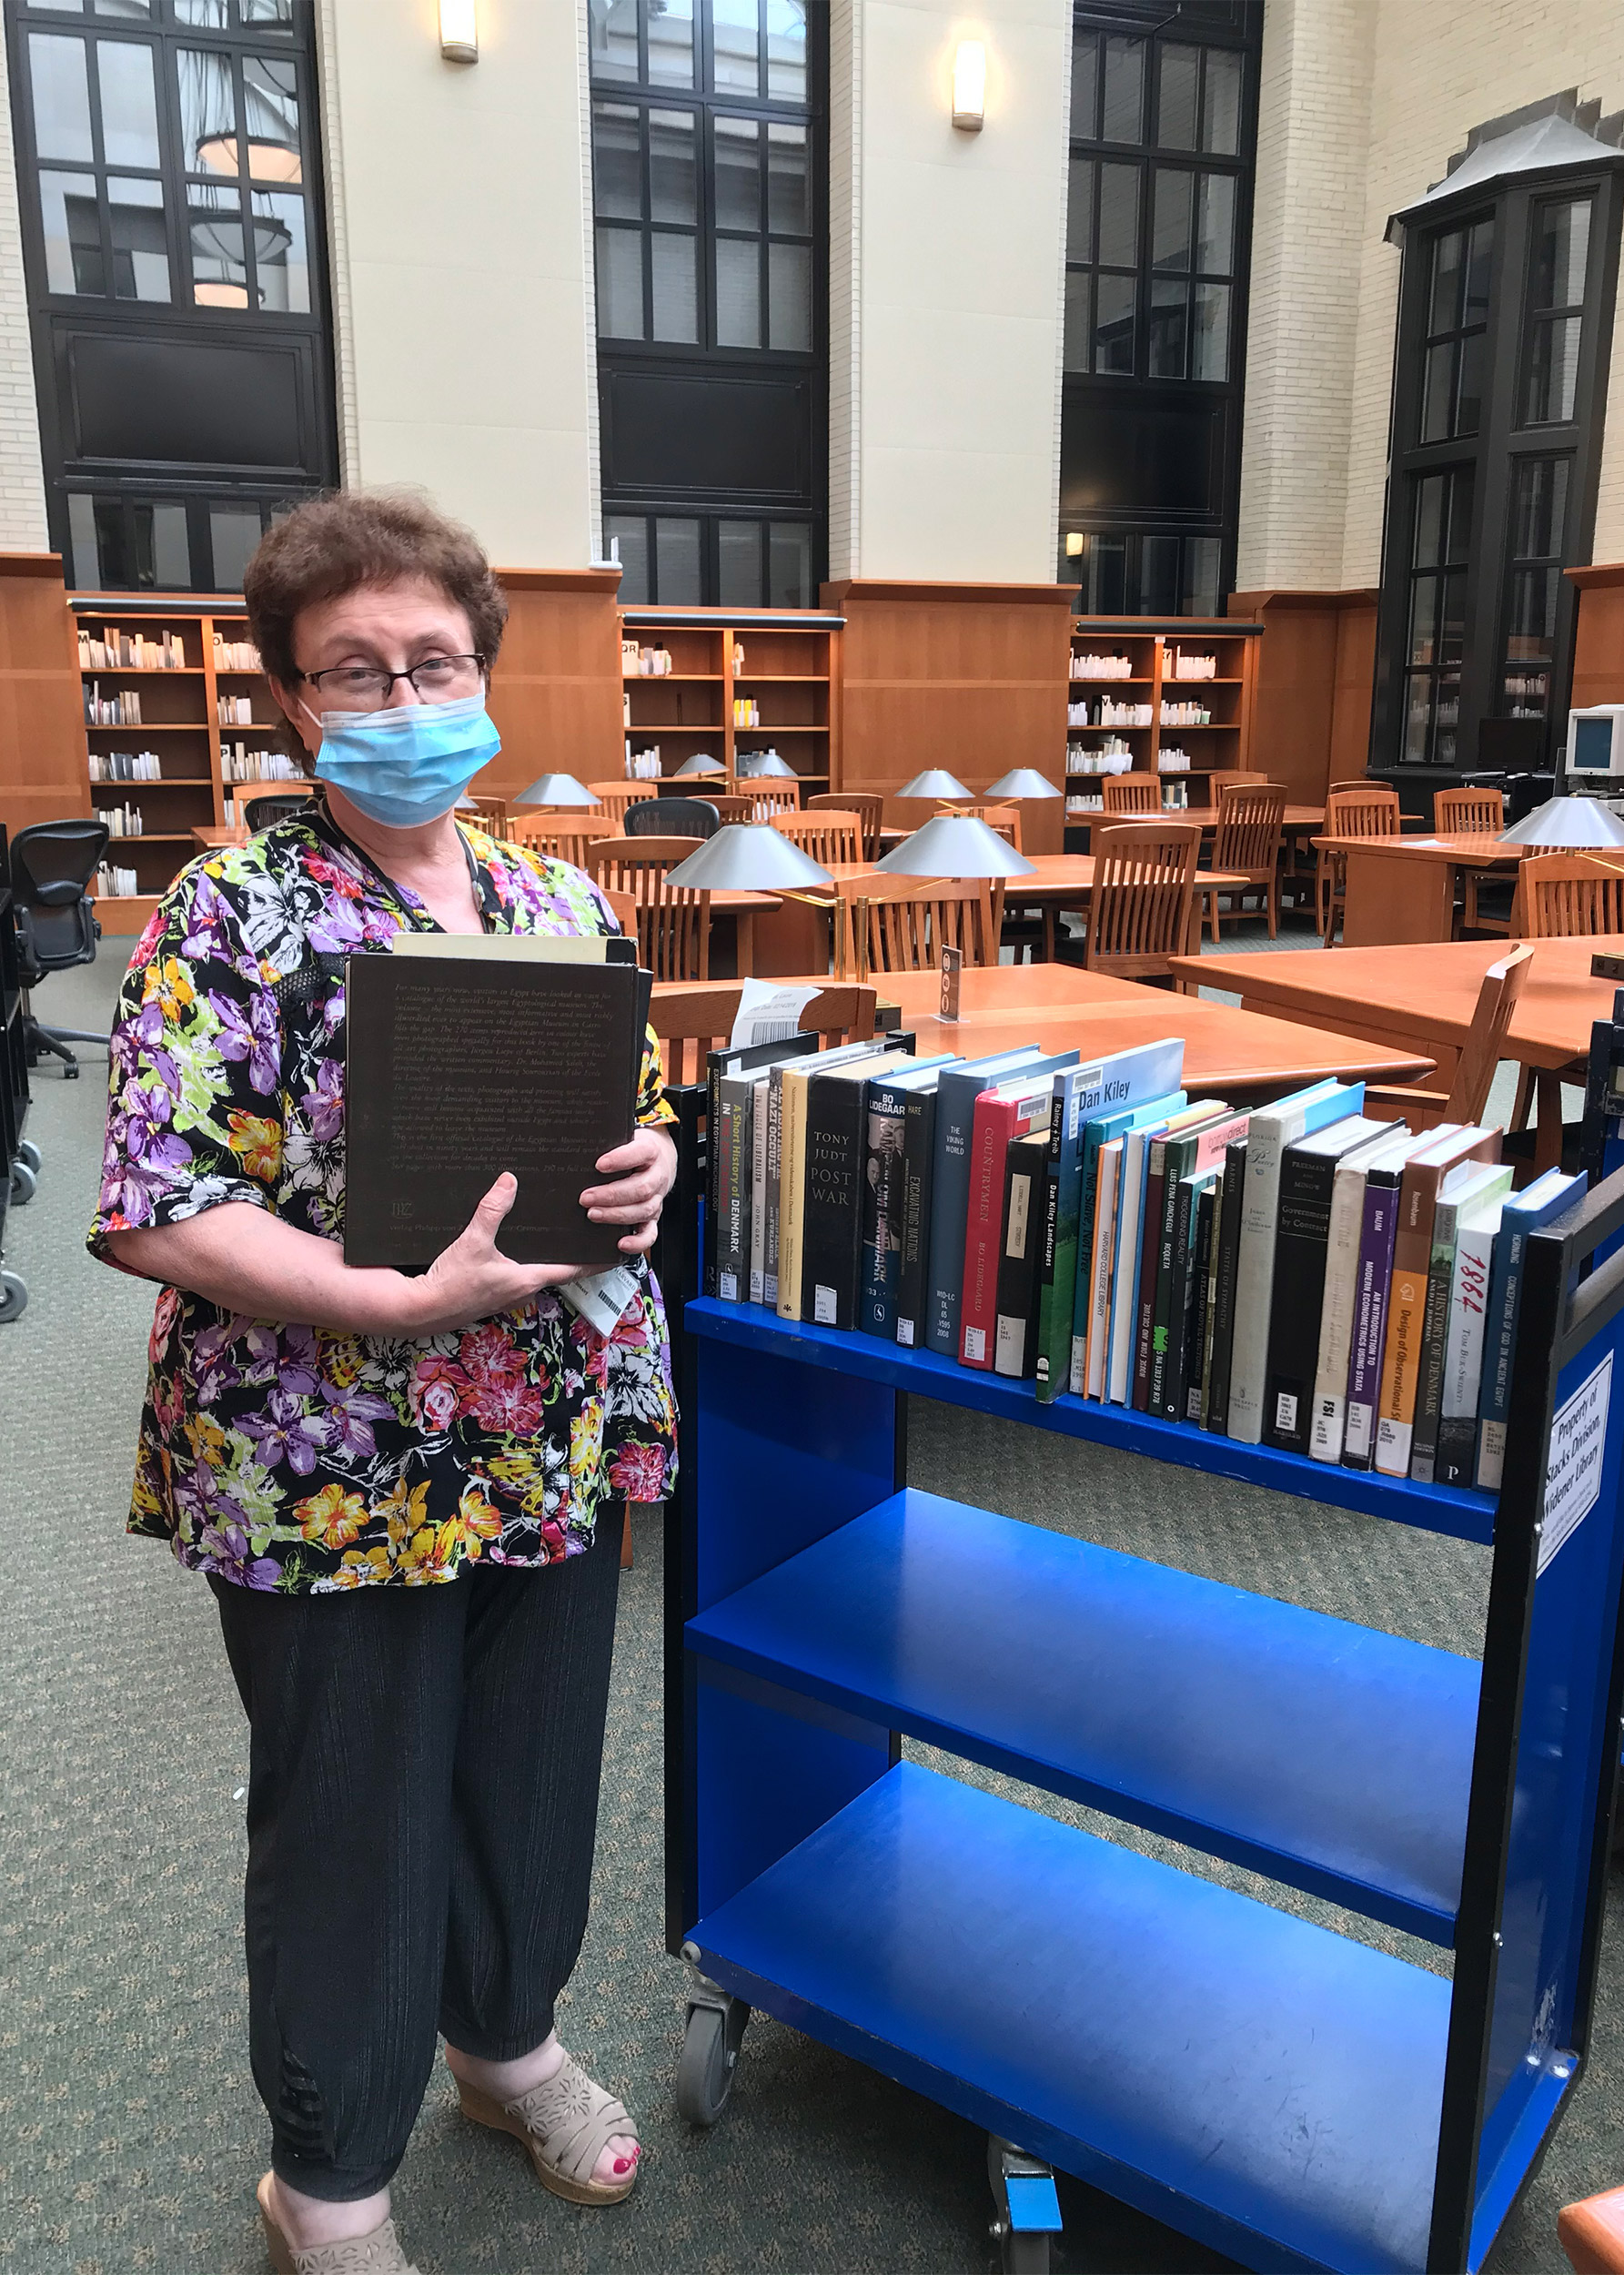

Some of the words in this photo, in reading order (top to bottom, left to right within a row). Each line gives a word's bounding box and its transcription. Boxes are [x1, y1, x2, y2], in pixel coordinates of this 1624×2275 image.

[712, 1067, 721, 1117] EXPERIMENTS
[882, 1093, 894, 1105] BO
[1078, 1091, 1100, 1111] Dan
[1104, 1080, 1131, 1105] Kiley
[721, 1102, 731, 1116] IN
[732, 1104, 742, 1115] A
[869, 1099, 906, 1116] LIDEGAAR
[1051, 1103, 1063, 1127] Rainey
[712, 1117, 720, 1126] IN
[731, 1114, 742, 1143] Short
[755, 1108, 763, 1130] FACES
[950, 1125, 961, 1135] THE
[711, 1126, 720, 1158] EGYPTIAN
[754, 1133, 762, 1142] OF
[814, 1131, 850, 1146] TONY
[945, 1134, 964, 1146] VIKING
[1051, 1136, 1061, 1154] Treib
[814, 1148, 848, 1162] JUDT
[945, 1144, 965, 1157] WORLD
[729, 1145, 741, 1185] History
[754, 1143, 762, 1184] LIBERALISM
[979, 1126, 995, 1222] COUNTRYMEN
[1291, 1160, 1326, 1171] FREEMAN
[811, 1168, 852, 1186] POST
[1086, 1171, 1097, 1191] Not
[1169, 1168, 1178, 1183] LUIS
[1228, 1162, 1236, 1193] BARNES
[730, 1185, 741, 1198] of
[812, 1187, 850, 1206] WAR
[909, 1176, 921, 1225] EXCAVATING
[1048, 1184, 1057, 1199] Dan
[1046, 1200, 1056, 1221] Kiley
[1083, 1193, 1096, 1227] Slave,
[1177, 1195, 1190, 1237] TRIGGERING
[1282, 1205, 1329, 1220] Government
[1410, 1190, 1423, 1227] Rosenbaum
[730, 1198, 741, 1254] DENMARK
[1282, 1217, 1291, 1228] by
[1293, 1218, 1327, 1232] Contract
[1374, 1209, 1385, 1231] BAUM
[873, 1210, 890, 1283] DANMARK
[906, 1226, 920, 1263] NATIONS
[977, 1241, 987, 1255] BO
[1044, 1222, 1055, 1267] Landscapes
[1082, 1228, 1093, 1249] Not
[1100, 1230, 1110, 1261] HARVARD
[1509, 1234, 1522, 1264] HORNUNG
[1080, 1251, 1091, 1275] Free
[1162, 1242, 1172, 1269] ROQUETA
[1176, 1238, 1187, 1266] REALITY
[1223, 1246, 1232, 1273] STATES
[973, 1257, 986, 1312] LIDEGAARD
[1098, 1261, 1108, 1290] COLLEGE
[1199, 1273, 1208, 1299] ATLAS
[1222, 1276, 1229, 1286] OF
[1363, 1260, 1375, 1291] MODERN
[1437, 1280, 1448, 1289] A
[1455, 1249, 1487, 1314] 1864
[936, 1289, 955, 1301] WID-LC
[940, 1300, 948, 1309] DL
[1096, 1290, 1105, 1319] LIBRARY
[1198, 1299, 1205, 1311] OF
[1372, 1291, 1382, 1302] AN
[1503, 1275, 1518, 1320] CONCEPTIONS
[1143, 1303, 1152, 1328] CULTURE
[1219, 1289, 1229, 1330] SYMPATHY
[1358, 1292, 1371, 1346] ECONOMETRICS
[1432, 1291, 1447, 1340] HISTORY
[936, 1328, 950, 1339] 2008
[1141, 1329, 1150, 1340] AND
[1196, 1311, 1205, 1337] NOVEL
[1367, 1303, 1381, 1354] INTRODUCTION
[1397, 1309, 1412, 1340] Design
[1502, 1321, 1512, 1330] OF
[1398, 1340, 1408, 1350] of
[1500, 1331, 1512, 1345] GOD
[1139, 1341, 1148, 1359] FORM
[1155, 1355, 1163, 1365] NA
[1194, 1338, 1204, 1380] TECTONICS
[1357, 1347, 1367, 1370] USING
[1367, 1356, 1377, 1366] TO
[1430, 1342, 1442, 1358] OF
[1499, 1347, 1510, 1356] IN
[1139, 1360, 1147, 1379] HOUSE
[1154, 1365, 1163, 1379] 1313
[1354, 1370, 1365, 1391] STATA
[1392, 1351, 1407, 1410] Observational
[1496, 1357, 1508, 1385] ANCIENT
[1153, 1379, 1162, 1391] P39
[1425, 1360, 1441, 1416] DENMARK
[1152, 1391, 1161, 1403] R78
[1494, 1386, 1505, 1408] EGYPT
[1322, 1400, 1335, 1418] FSI
[1558, 1399, 1589, 1444] Property
[1589, 1381, 1599, 1408] of
[1547, 1450, 1570, 1484] Stacks
[1571, 1414, 1600, 1459] Division.
[1447, 1465, 1459, 1481] P
[1544, 1473, 1574, 1521] Widener
[1576, 1442, 1599, 1482] Library
